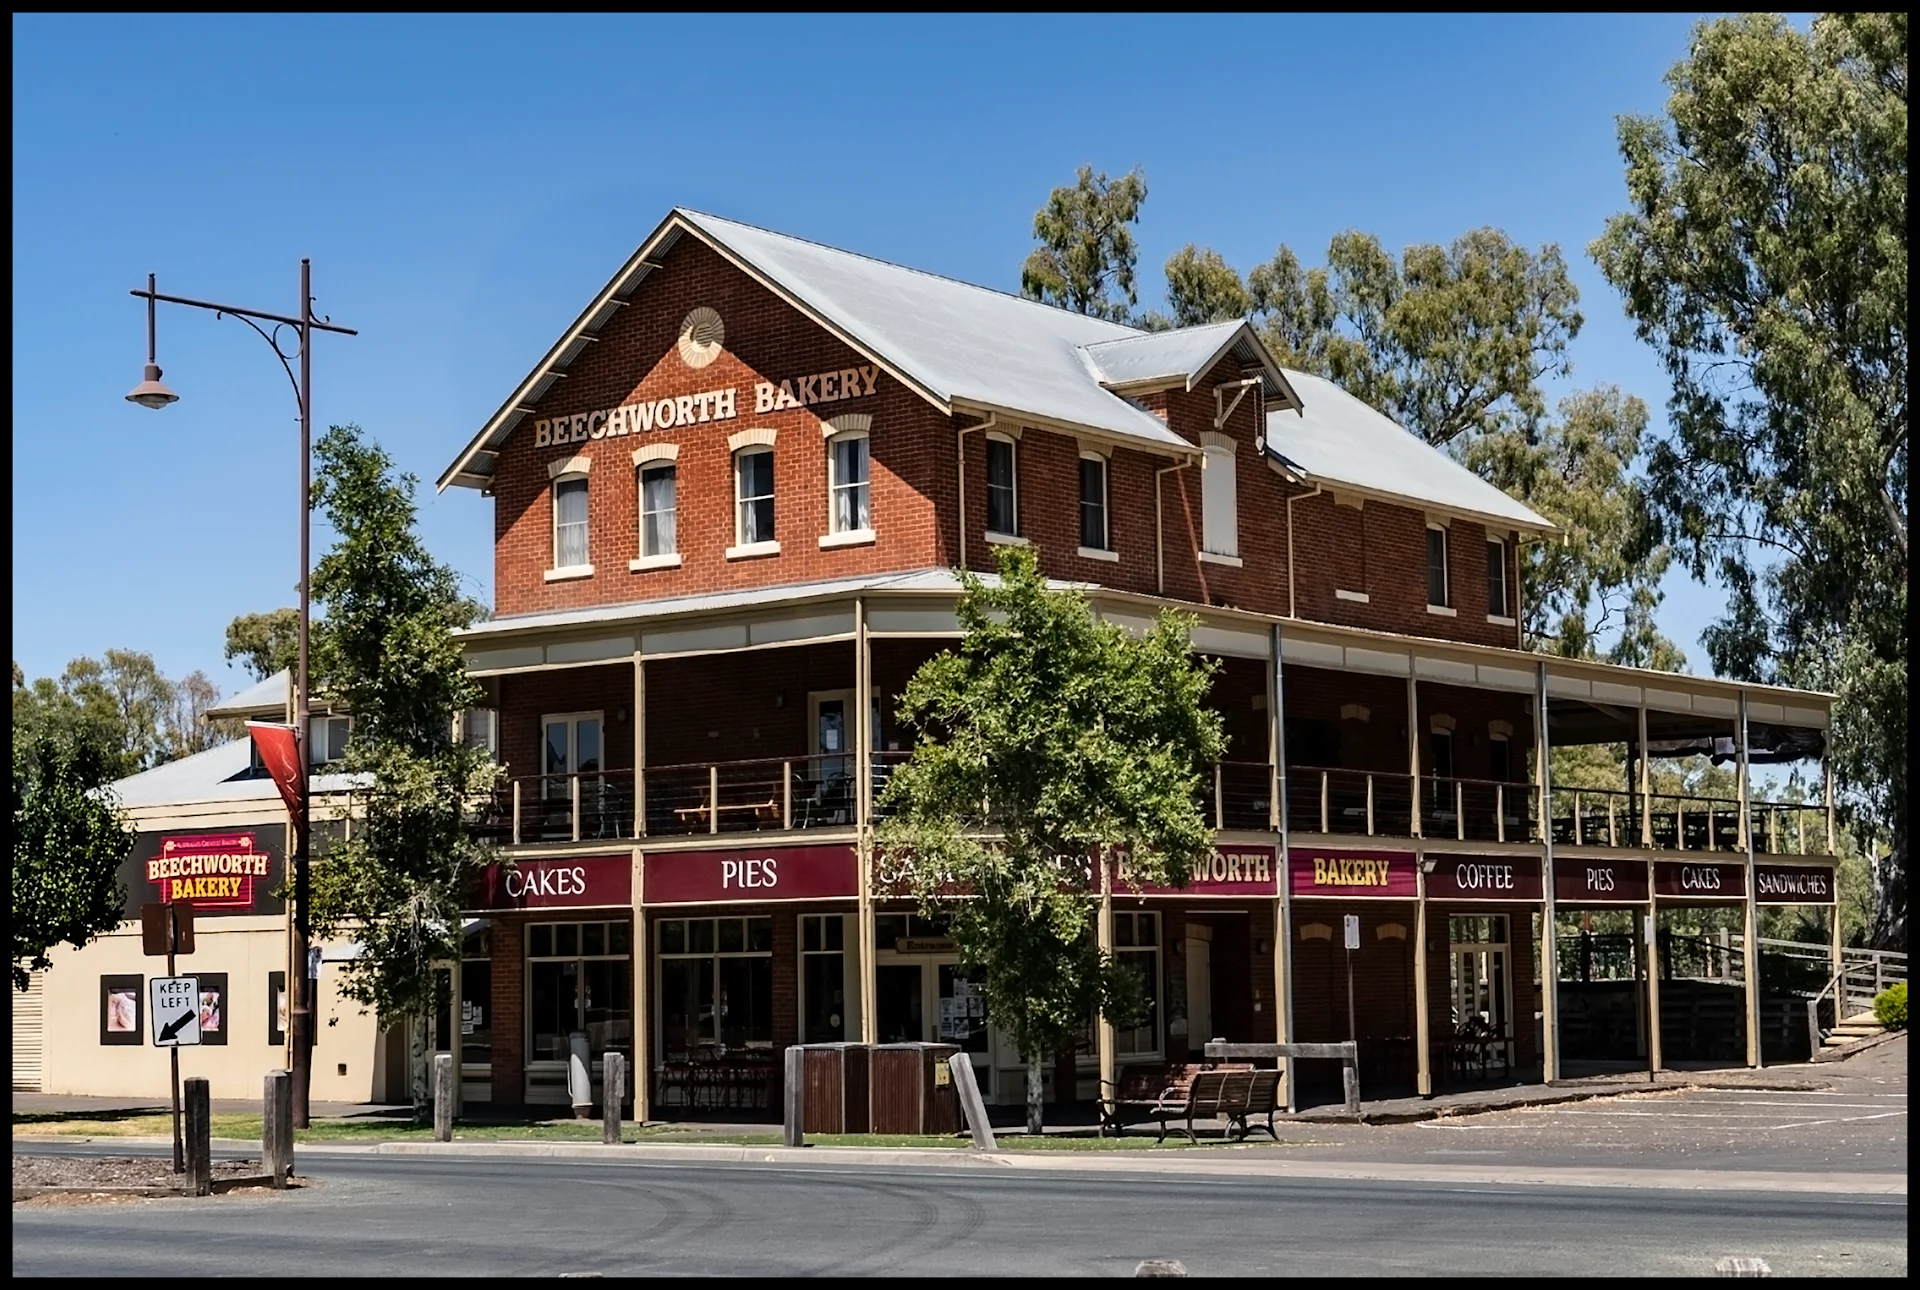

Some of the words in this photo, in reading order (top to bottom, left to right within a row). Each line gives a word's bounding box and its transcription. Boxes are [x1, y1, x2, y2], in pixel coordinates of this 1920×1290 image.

[534, 387, 737, 449] BEECHWORTH
[754, 364, 882, 414] BAKERY
[148, 854, 269, 881] BEECHWORTH
[721, 857, 778, 890] PIES
[1313, 857, 1390, 887] BAKERY
[1456, 863, 1514, 889] COFFEE
[1586, 867, 1615, 892] PIES
[1681, 866, 1721, 890] CAKES
[171, 876, 242, 900] BAKERY
[505, 866, 587, 898] CAKES
[1758, 872, 1827, 896] SANDWICHES
[159, 982, 191, 994] KEEP
[161, 997, 190, 1009] LEFT
